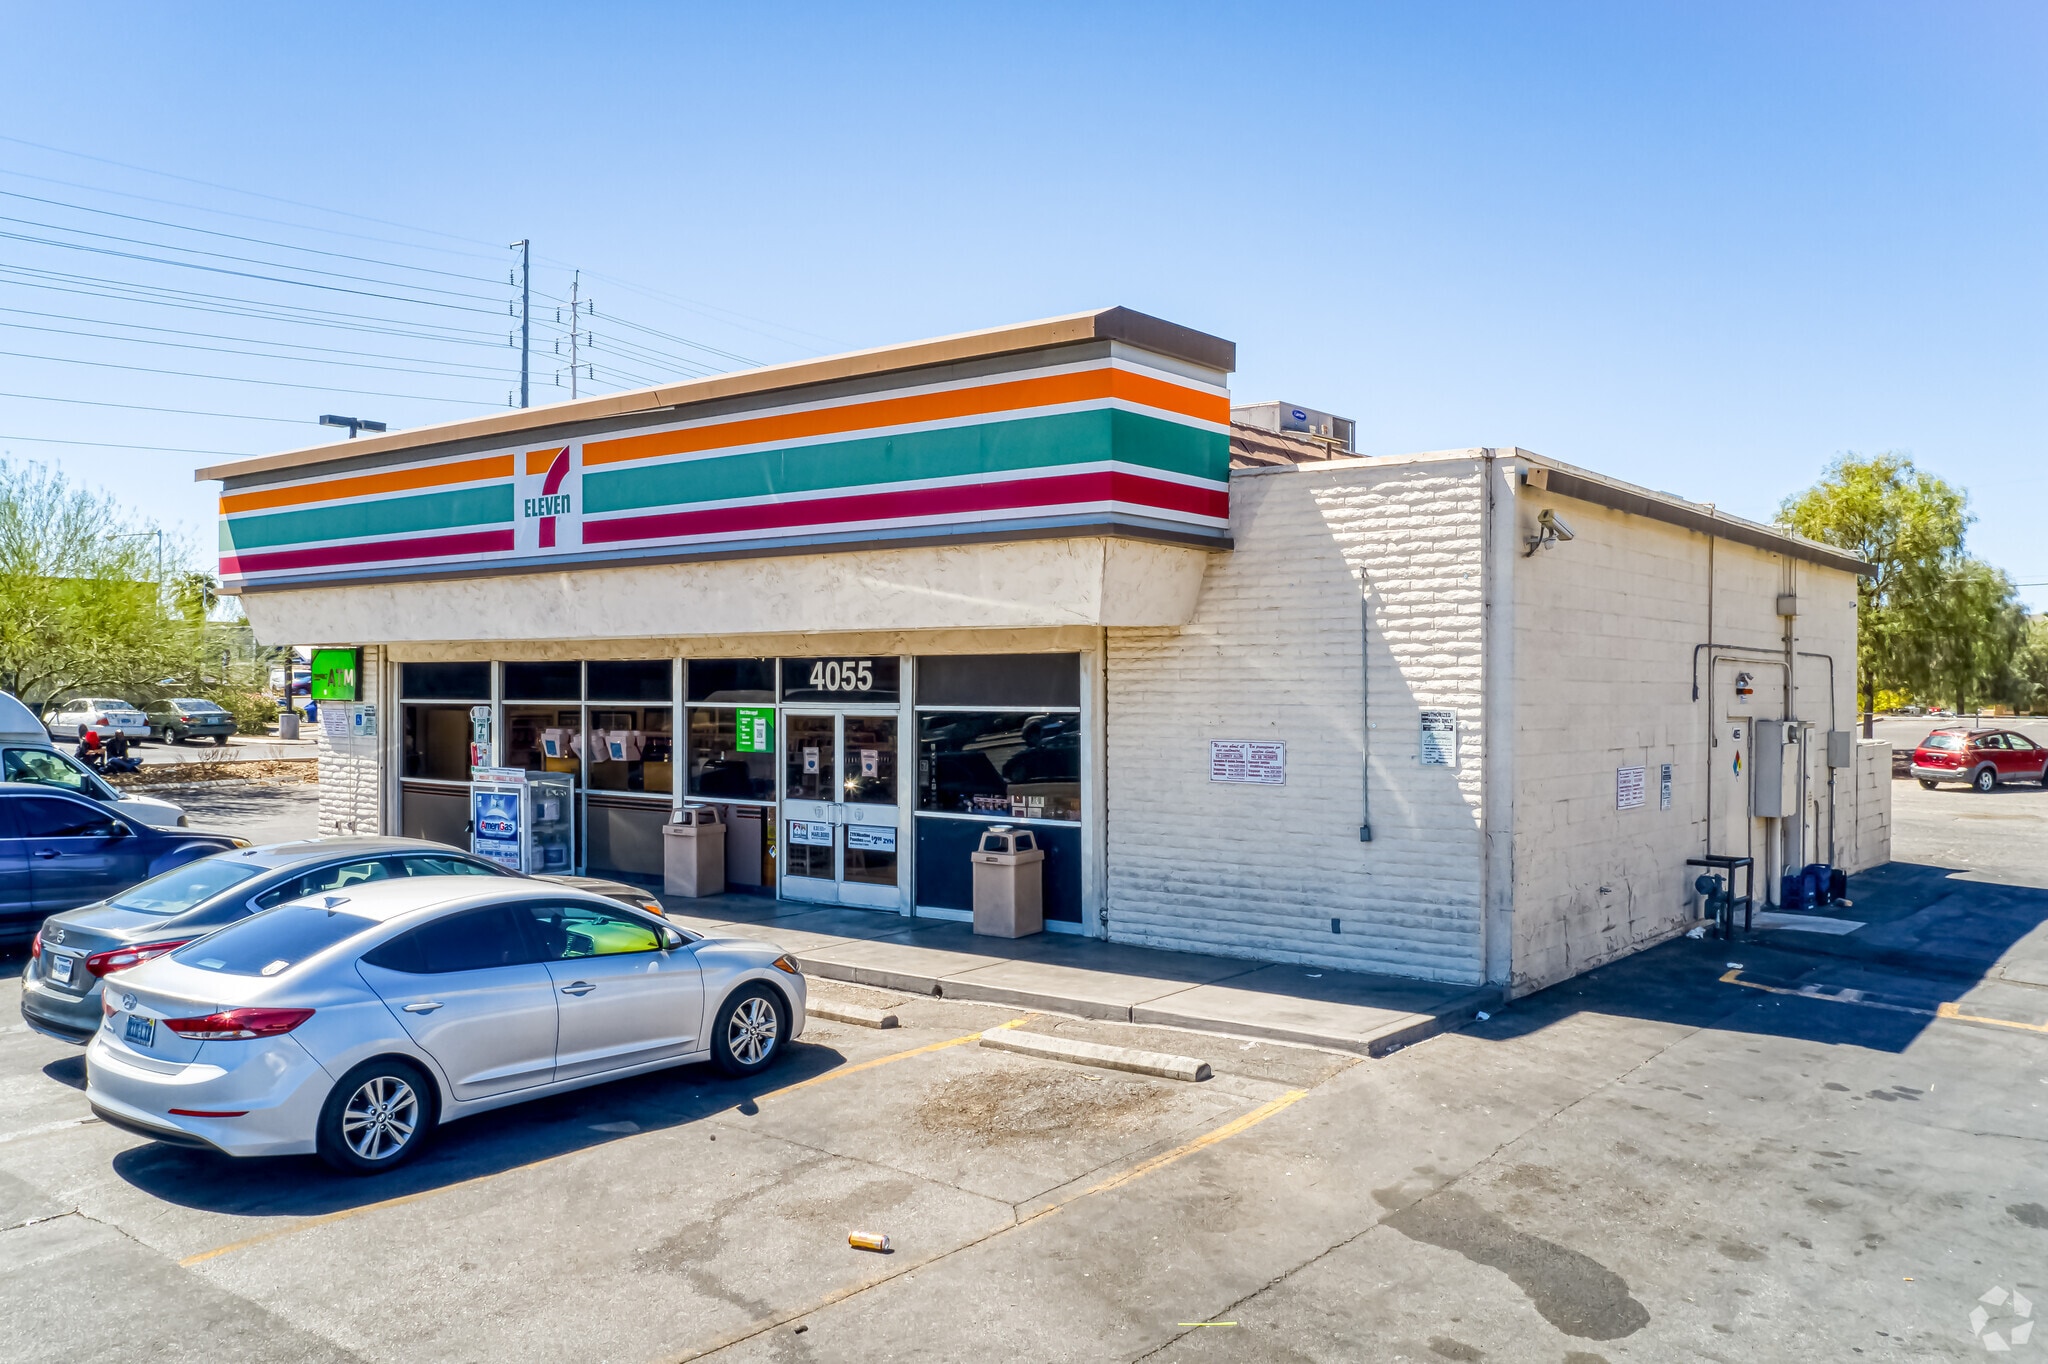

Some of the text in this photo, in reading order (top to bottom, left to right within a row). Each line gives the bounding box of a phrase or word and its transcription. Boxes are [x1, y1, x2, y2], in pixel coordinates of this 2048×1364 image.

[327, 668, 354, 687] ATM
[810, 661, 872, 691] 4055
[480, 820, 513, 831] AmeriGas
